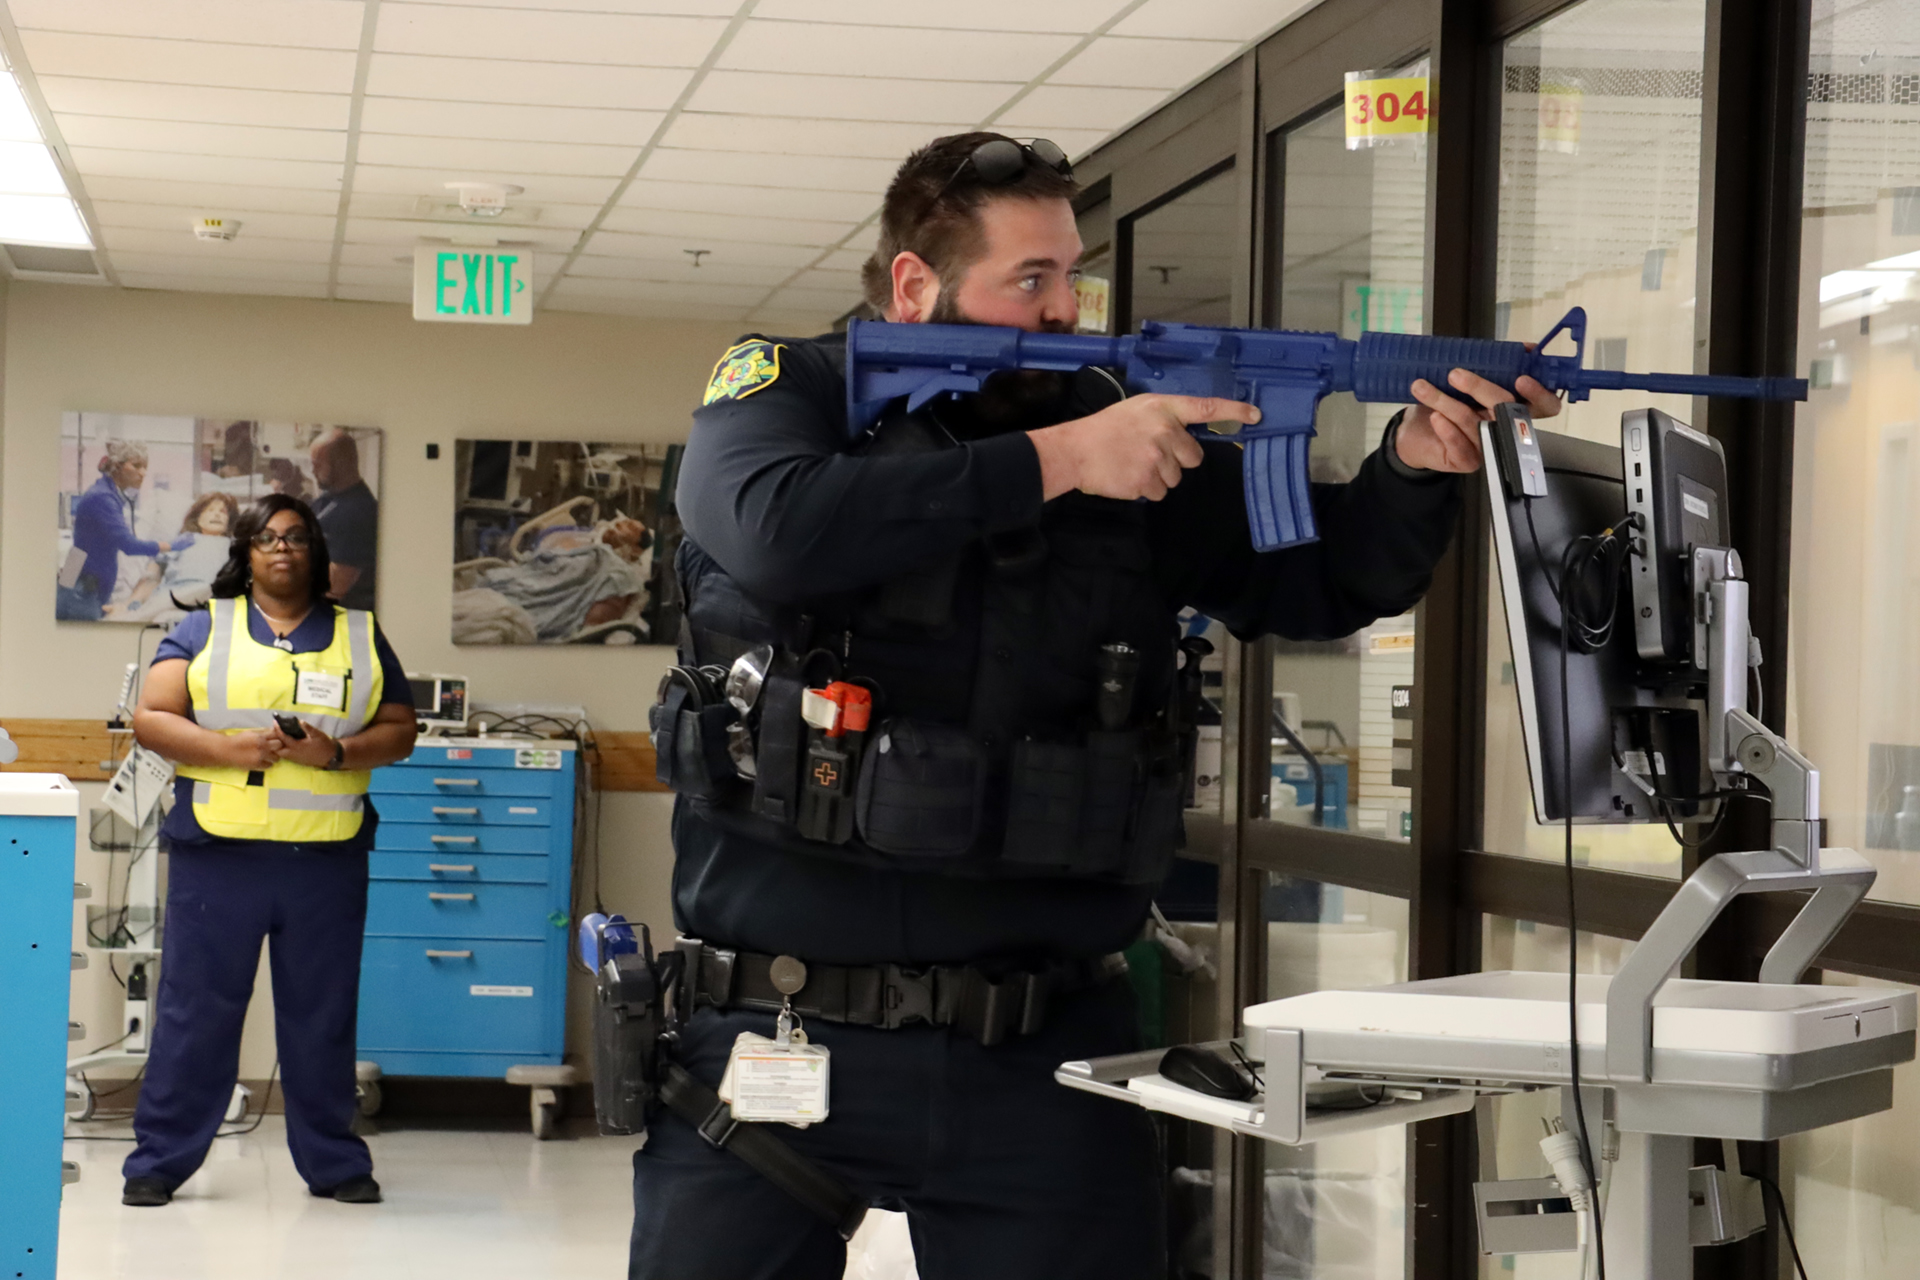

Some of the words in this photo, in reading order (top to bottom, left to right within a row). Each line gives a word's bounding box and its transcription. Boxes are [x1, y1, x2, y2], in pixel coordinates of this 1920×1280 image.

[1351, 90, 1428, 125] 304
[435, 252, 518, 317] EXIT
[1392, 689, 1411, 708] 0304
